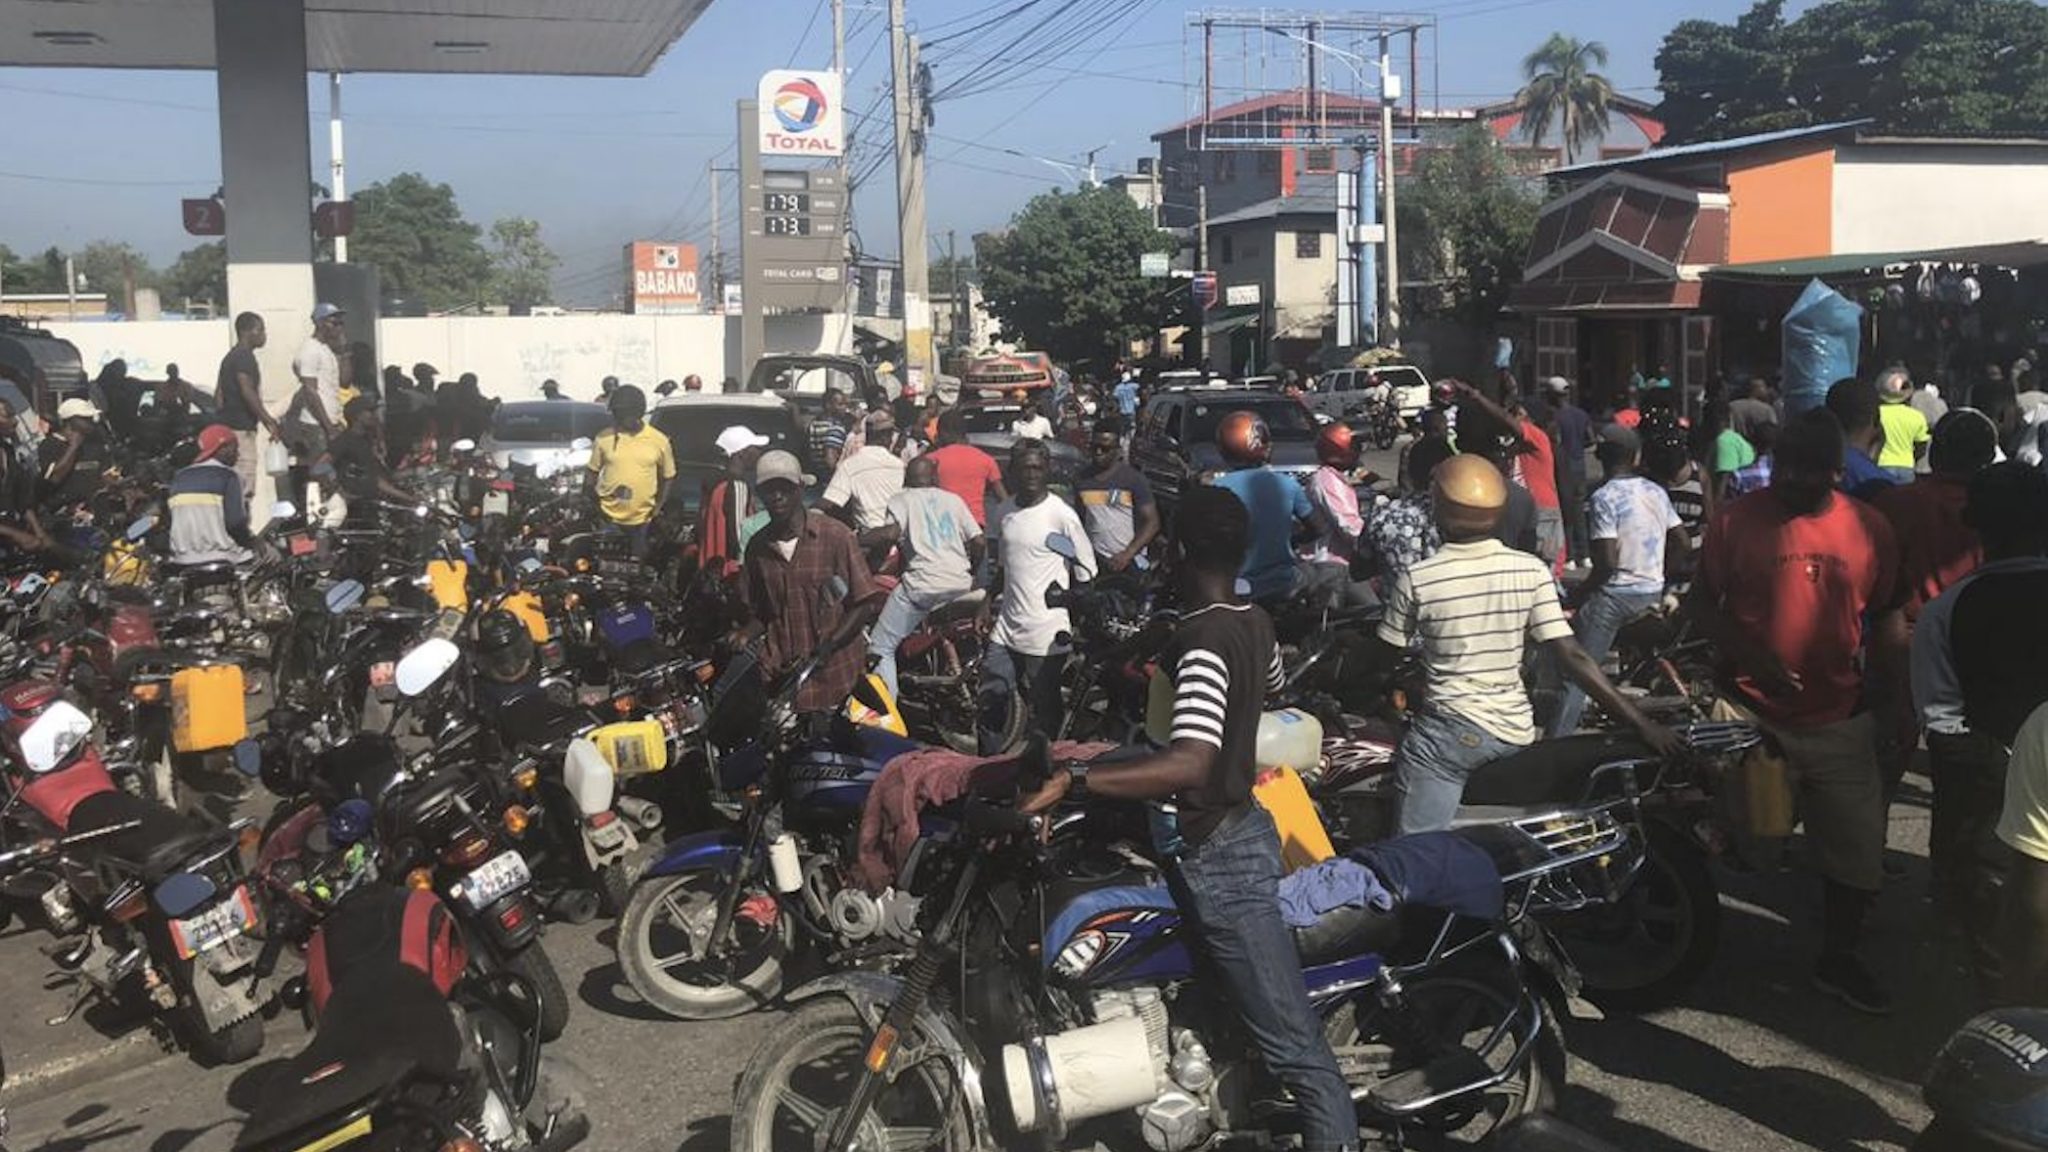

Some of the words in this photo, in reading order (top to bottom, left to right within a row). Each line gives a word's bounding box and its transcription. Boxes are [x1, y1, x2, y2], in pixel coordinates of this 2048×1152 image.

[766, 133, 837, 150] TOTAL
[195, 206, 209, 229] 2
[329, 210, 340, 230] 1
[636, 271, 697, 295] BABAKO
